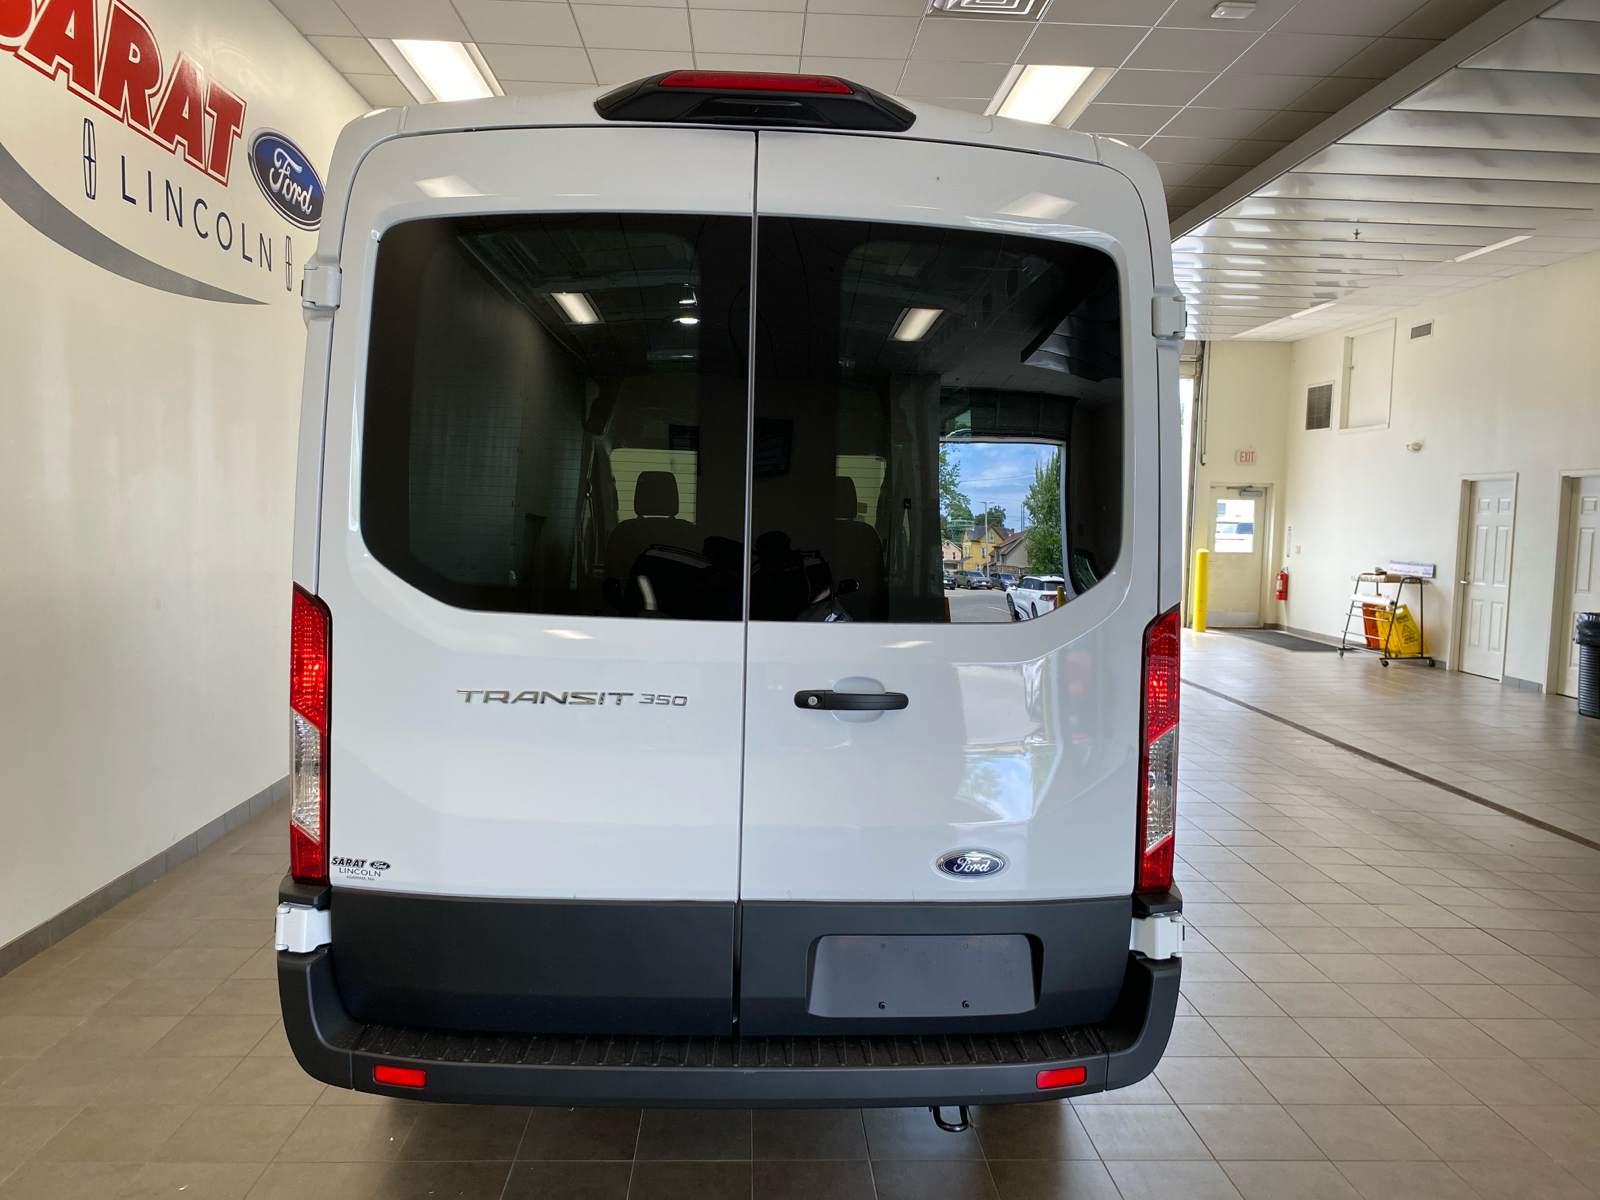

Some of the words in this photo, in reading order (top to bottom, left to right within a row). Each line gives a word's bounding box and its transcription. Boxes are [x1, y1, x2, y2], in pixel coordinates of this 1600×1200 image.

[0, 0, 247, 187] ARAT
[269, 147, 314, 215] Ford
[120, 154, 272, 272] LINCOLN
[1239, 451, 1254, 463] EXIT
[456, 689, 634, 706] TRANSIT
[638, 692, 688, 706] 350
[331, 856, 367, 868] SARAT
[953, 856, 991, 873] Ford
[339, 867, 381, 877] LINCOLN
